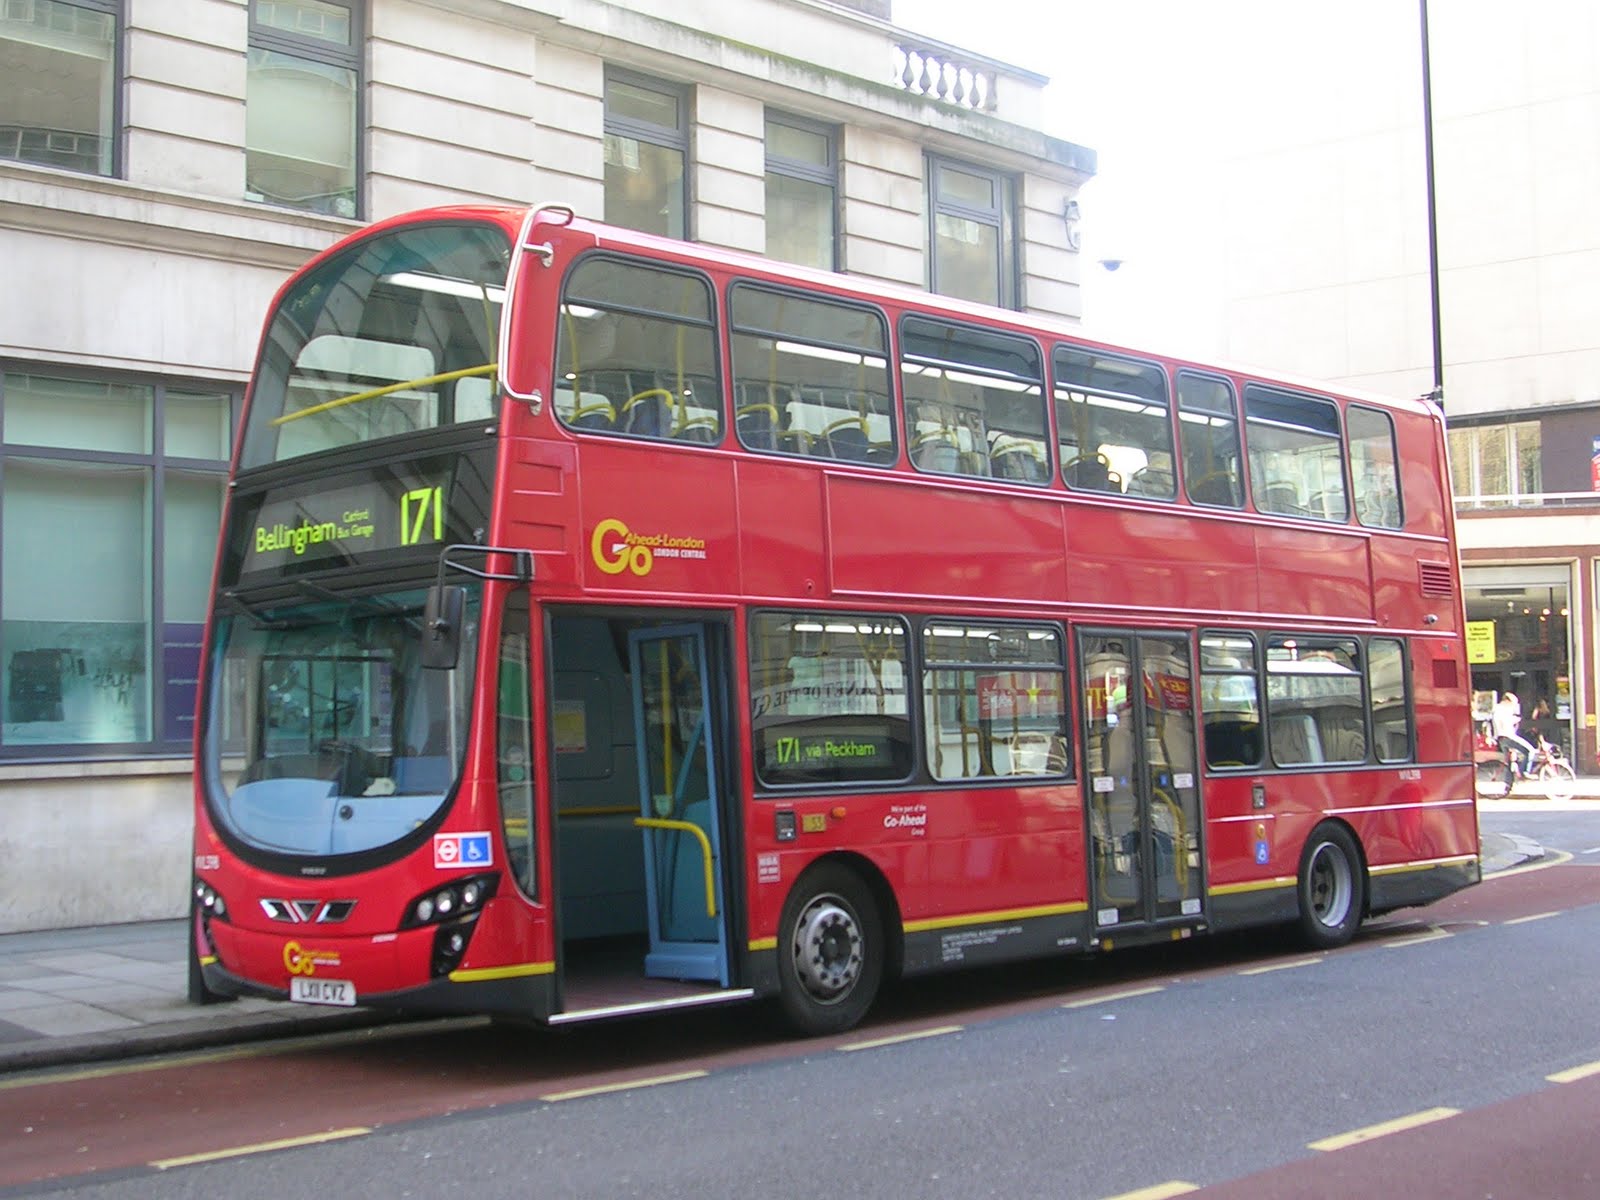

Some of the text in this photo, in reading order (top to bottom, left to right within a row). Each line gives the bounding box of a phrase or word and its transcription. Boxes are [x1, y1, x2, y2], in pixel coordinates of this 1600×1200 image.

[401, 486, 443, 546] 171
[255, 519, 337, 555] Bellingham
[591, 518, 653, 576] Go
[776, 736, 876, 764] 171 via Peckham
[884, 813, 926, 828] Go-Ahead
[300, 981, 345, 1001] LX11 CVZ
